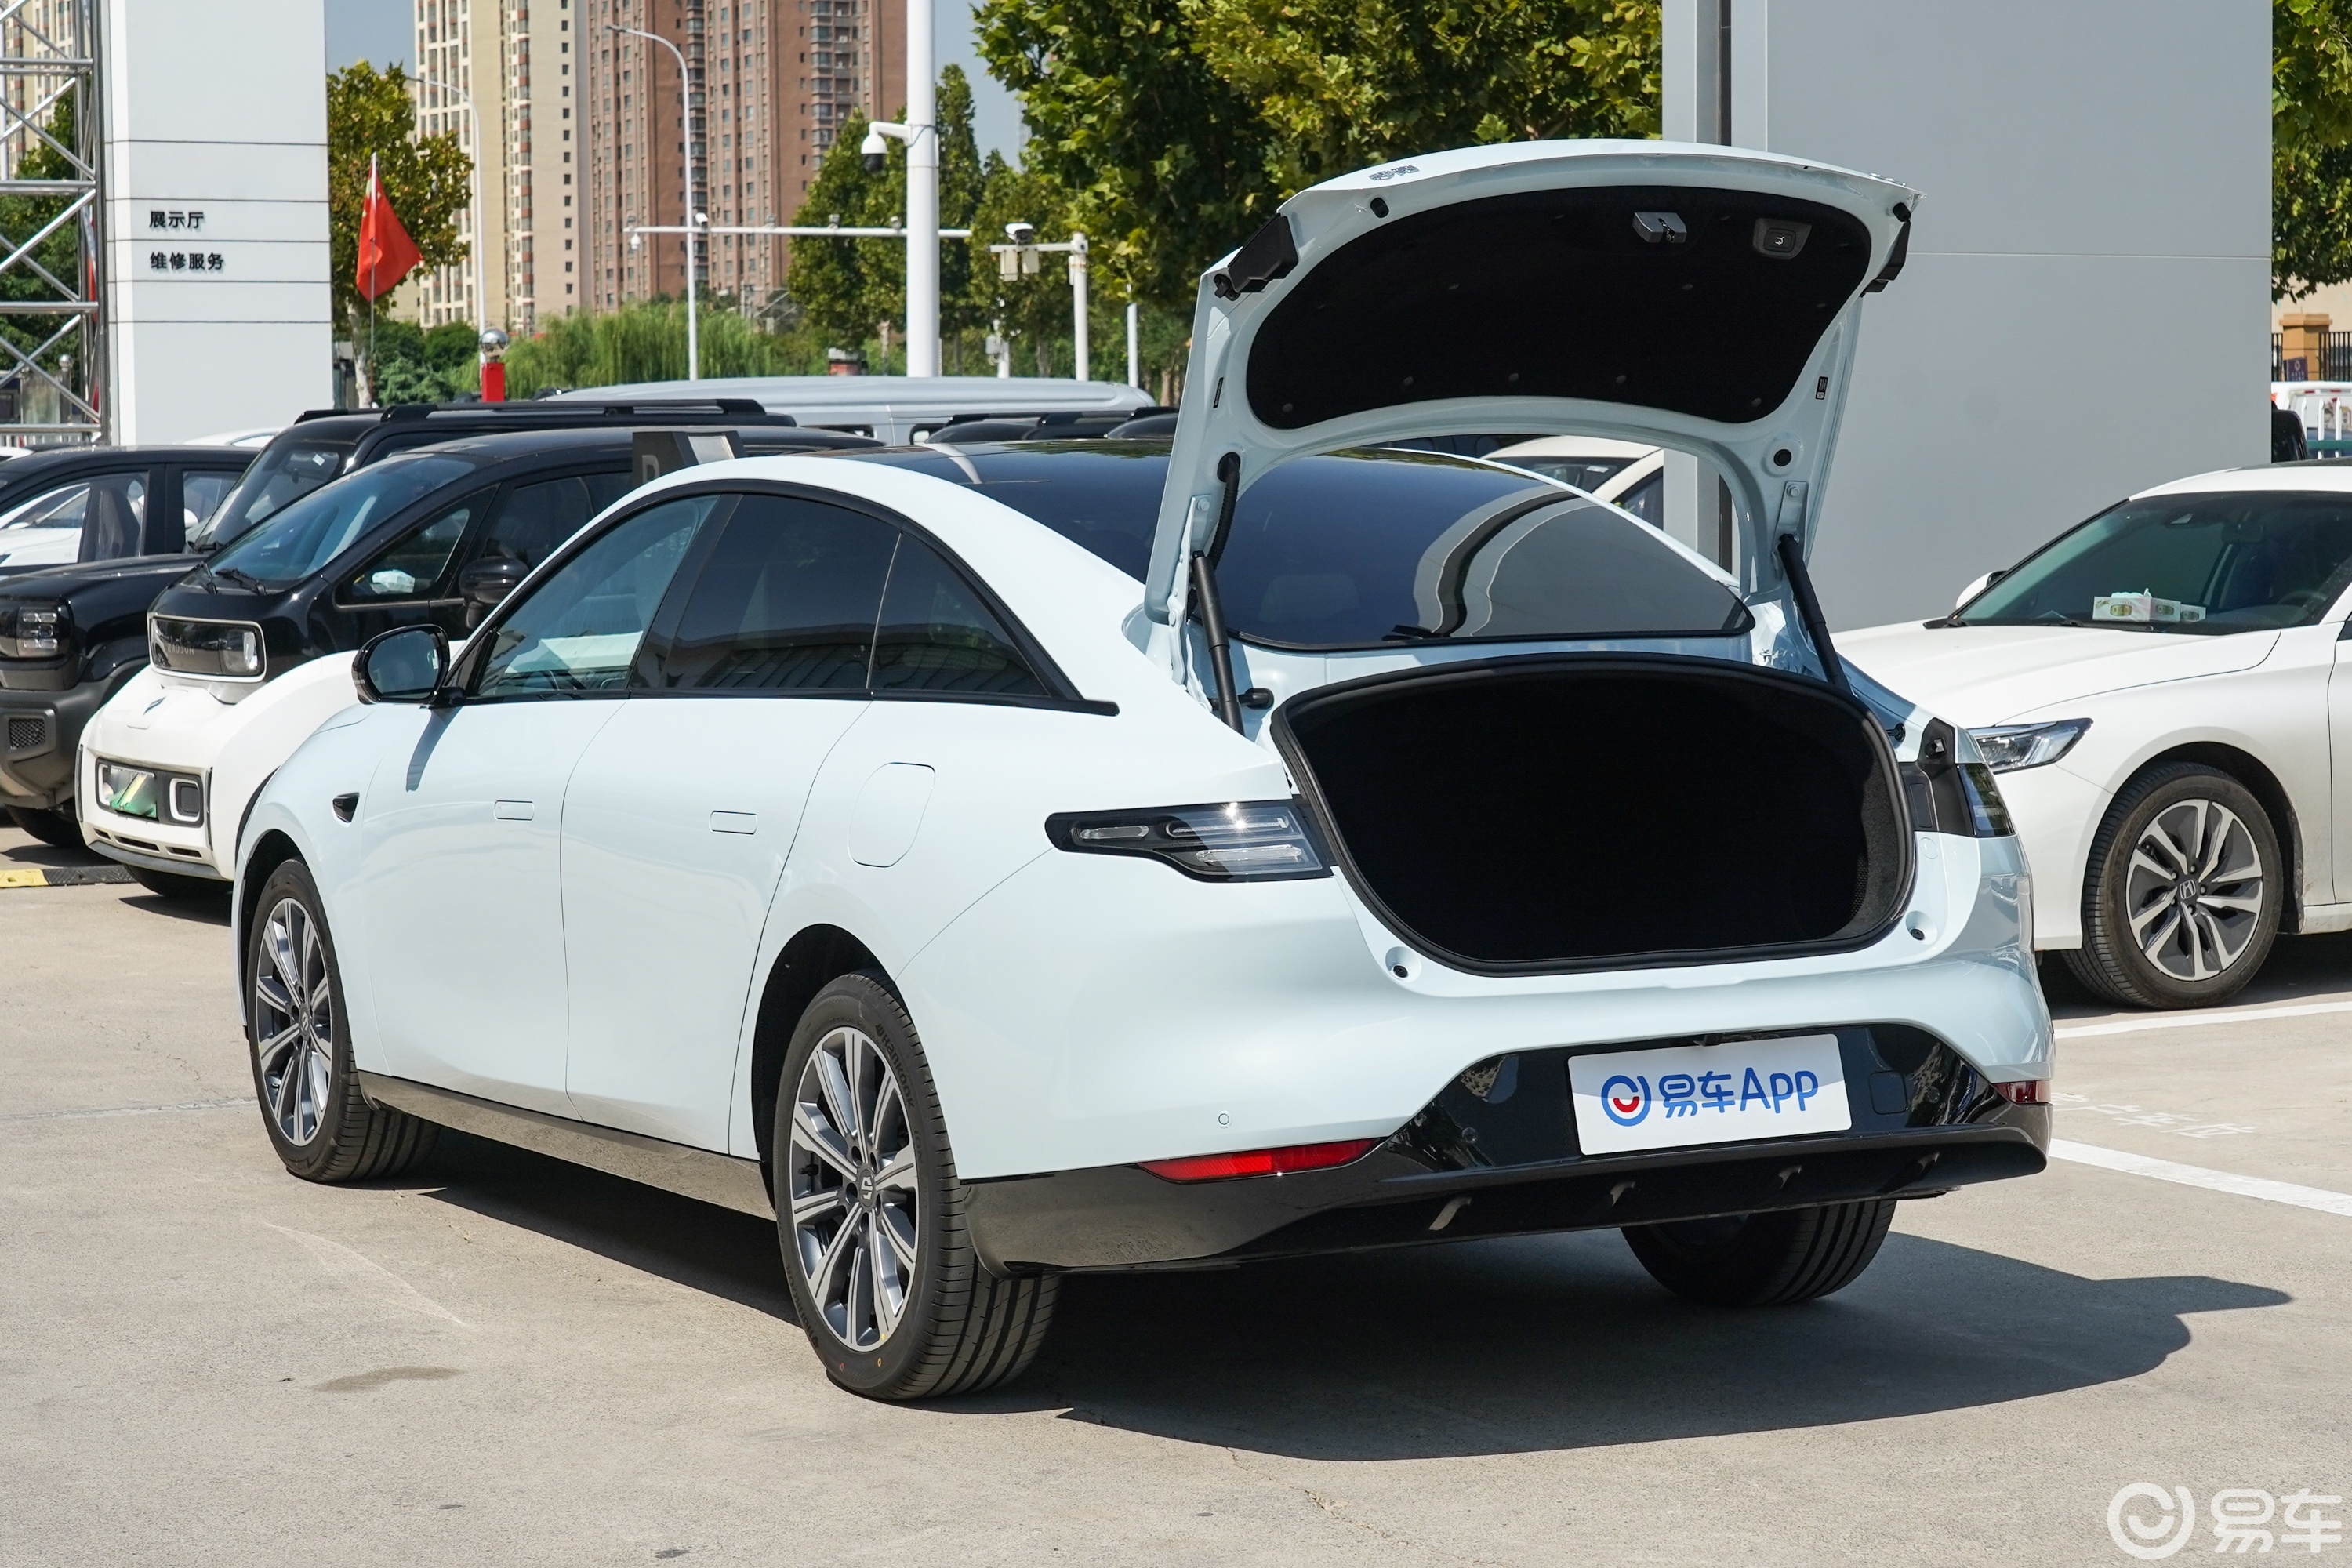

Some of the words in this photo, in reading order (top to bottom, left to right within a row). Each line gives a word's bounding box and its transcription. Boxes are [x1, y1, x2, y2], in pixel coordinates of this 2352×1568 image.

[149, 210, 205, 229] 展示厅
[150, 252, 224, 270] 维修服务
